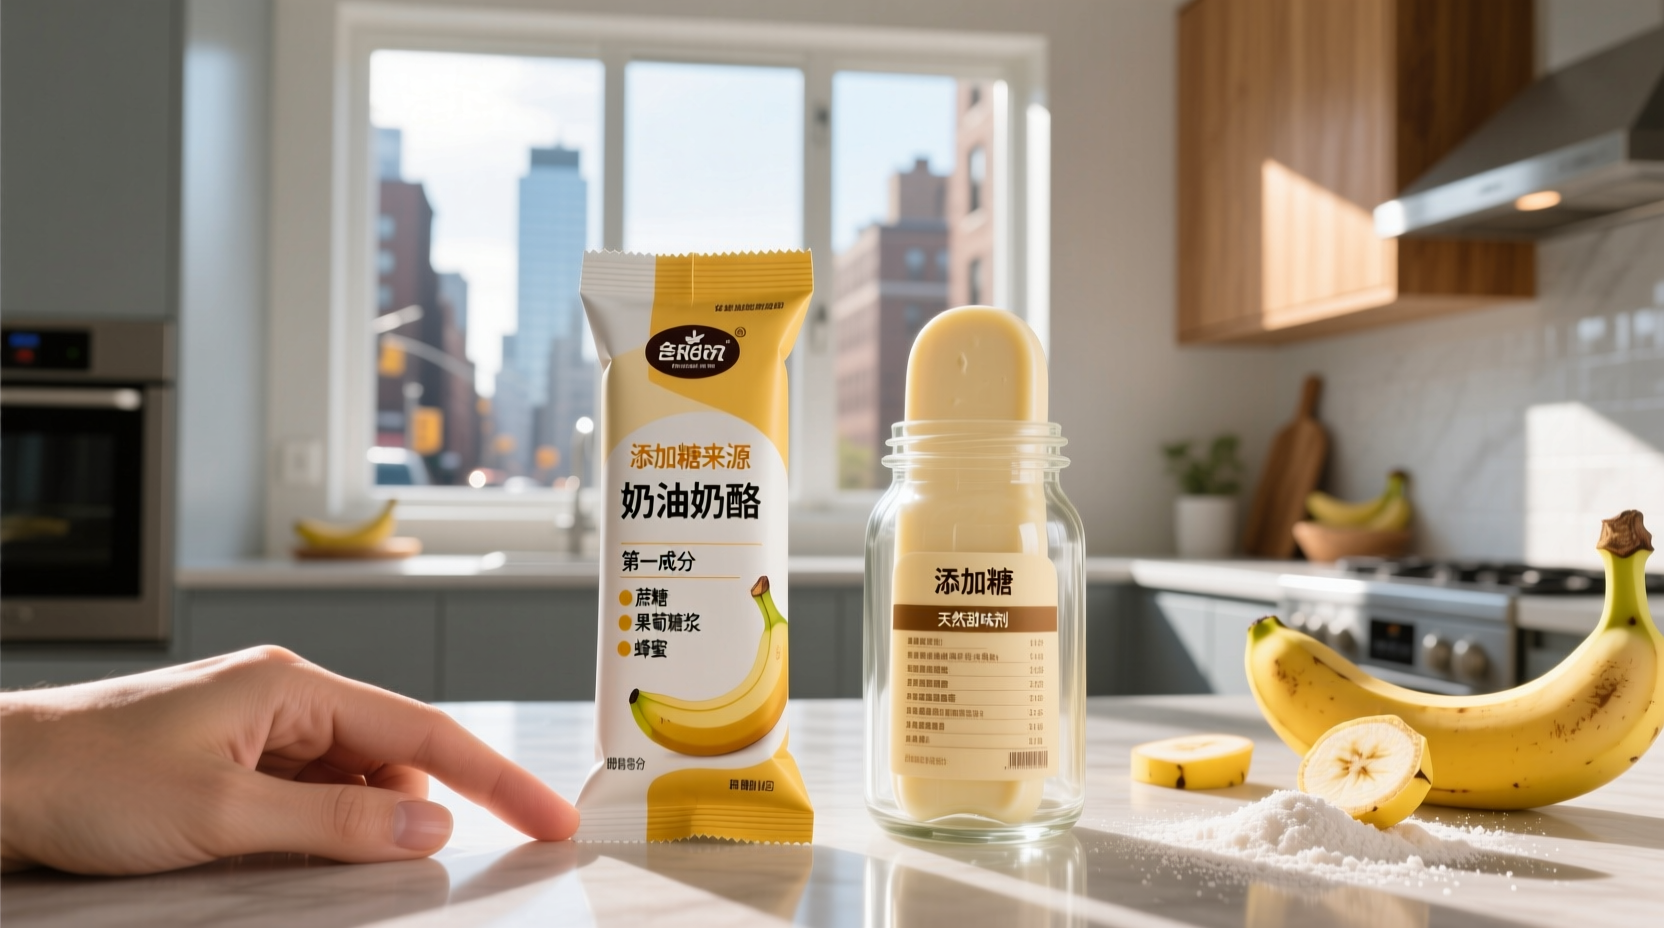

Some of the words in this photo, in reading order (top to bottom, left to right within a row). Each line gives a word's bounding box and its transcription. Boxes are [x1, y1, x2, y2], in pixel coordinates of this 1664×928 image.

[630, 442, 751, 470] 添加糖来源
[621, 481, 761, 519] 奶油奶酪
[935, 567, 1014, 596] 添加糖
[635, 587, 668, 607] 蔗糖
[634, 638, 668, 659] 蜂蜜
